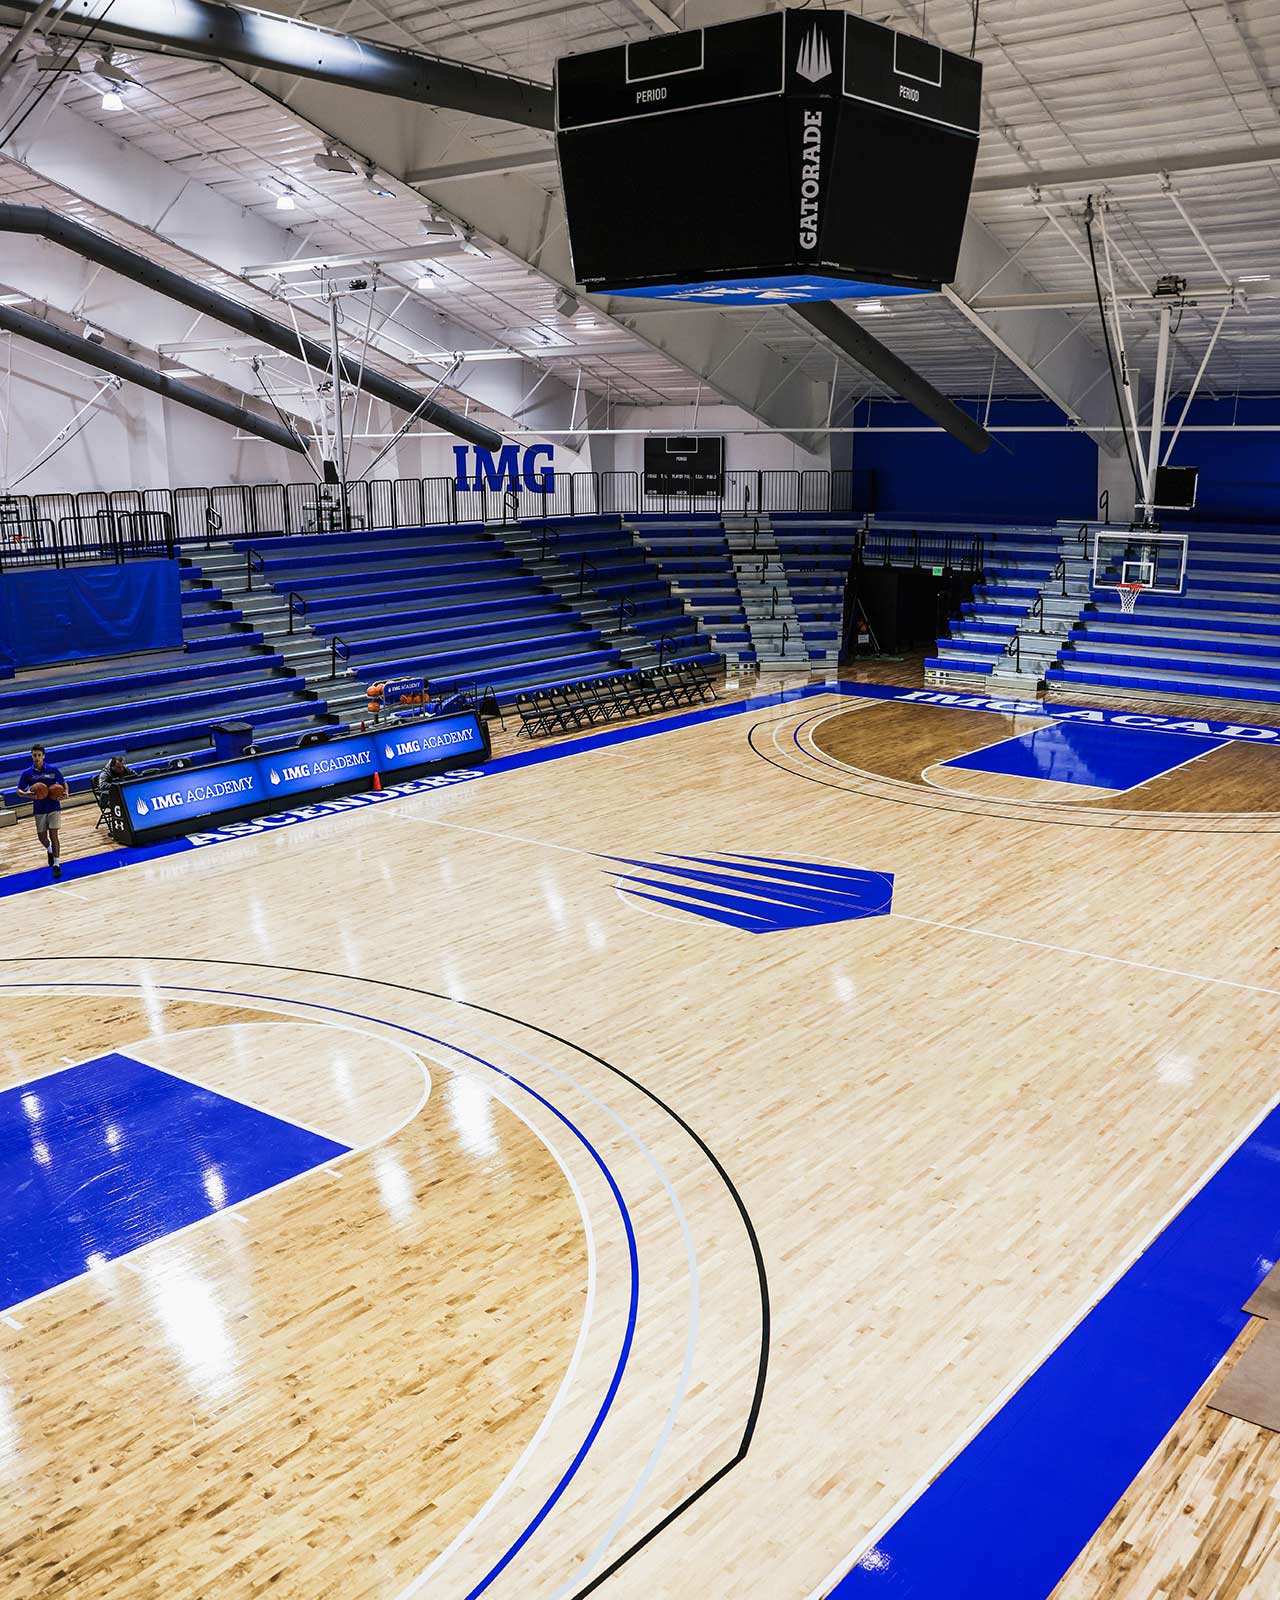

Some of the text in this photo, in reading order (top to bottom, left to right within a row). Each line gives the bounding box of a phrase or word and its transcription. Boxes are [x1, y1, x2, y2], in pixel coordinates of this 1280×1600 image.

[635, 86, 668, 104] PERIOD
[898, 84, 920, 102] PERIOD
[798, 110, 823, 250] GATORADE
[452, 443, 555, 494] IMG
[895, 690, 1280, 741] IMG ACAD
[396, 728, 474, 756] IMG ACADEMY
[282, 750, 372, 781] IMG ACADEMY
[151, 776, 253, 811] IMG ACADEMY
[184, 768, 485, 847] ASCENDERS
